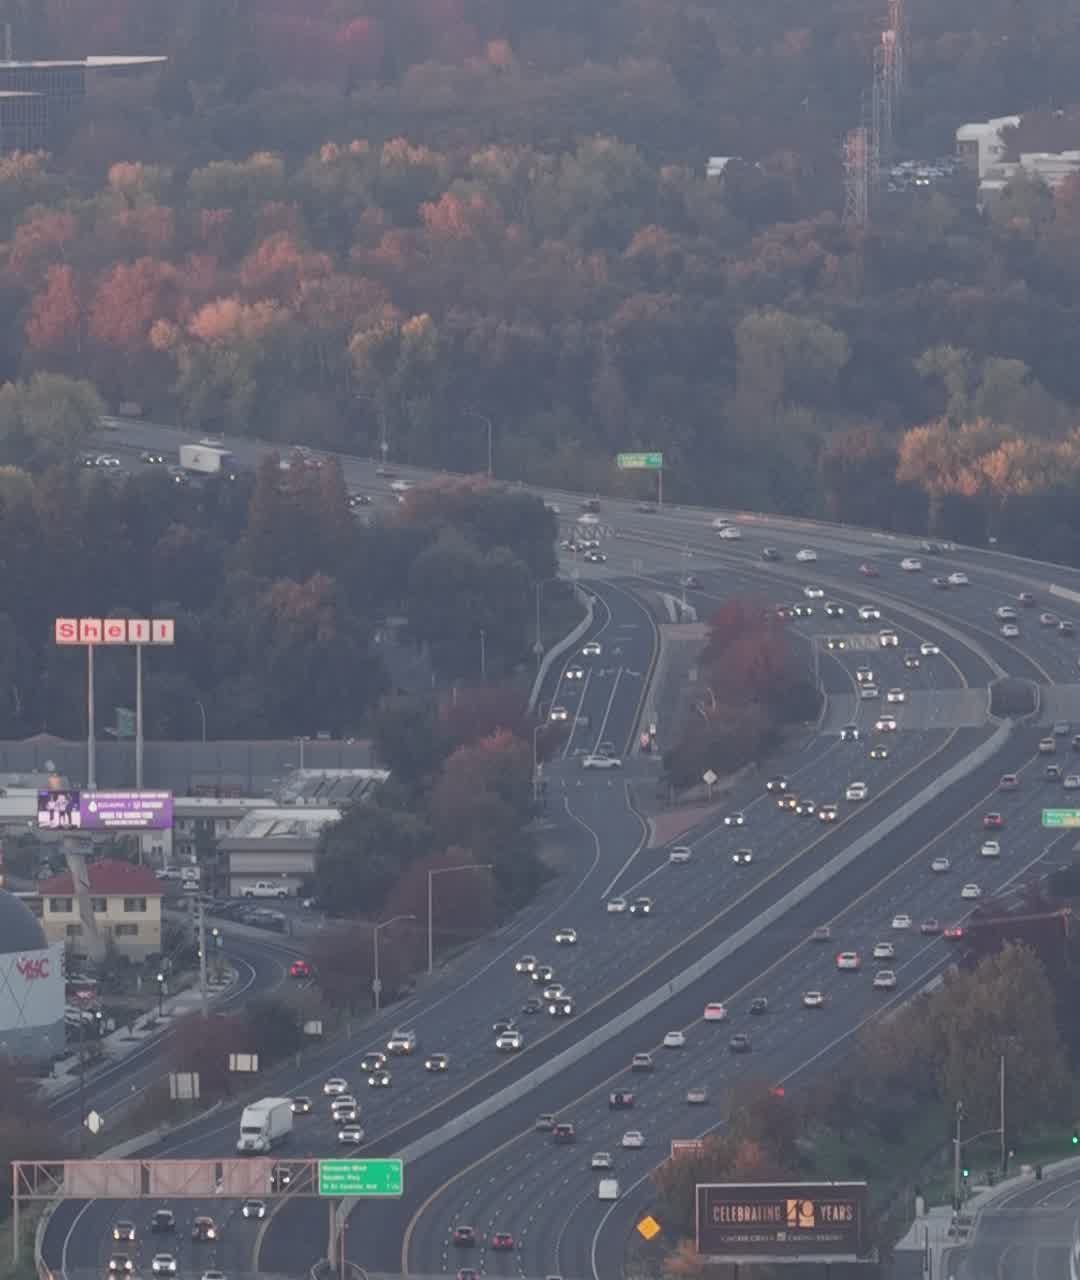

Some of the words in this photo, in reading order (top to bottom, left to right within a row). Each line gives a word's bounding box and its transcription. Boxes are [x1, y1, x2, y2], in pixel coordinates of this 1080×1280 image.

[59, 622, 167, 640] Shell
[712, 1203, 780, 1224] CELEBRATING
[819, 1204, 853, 1222] YEARS
